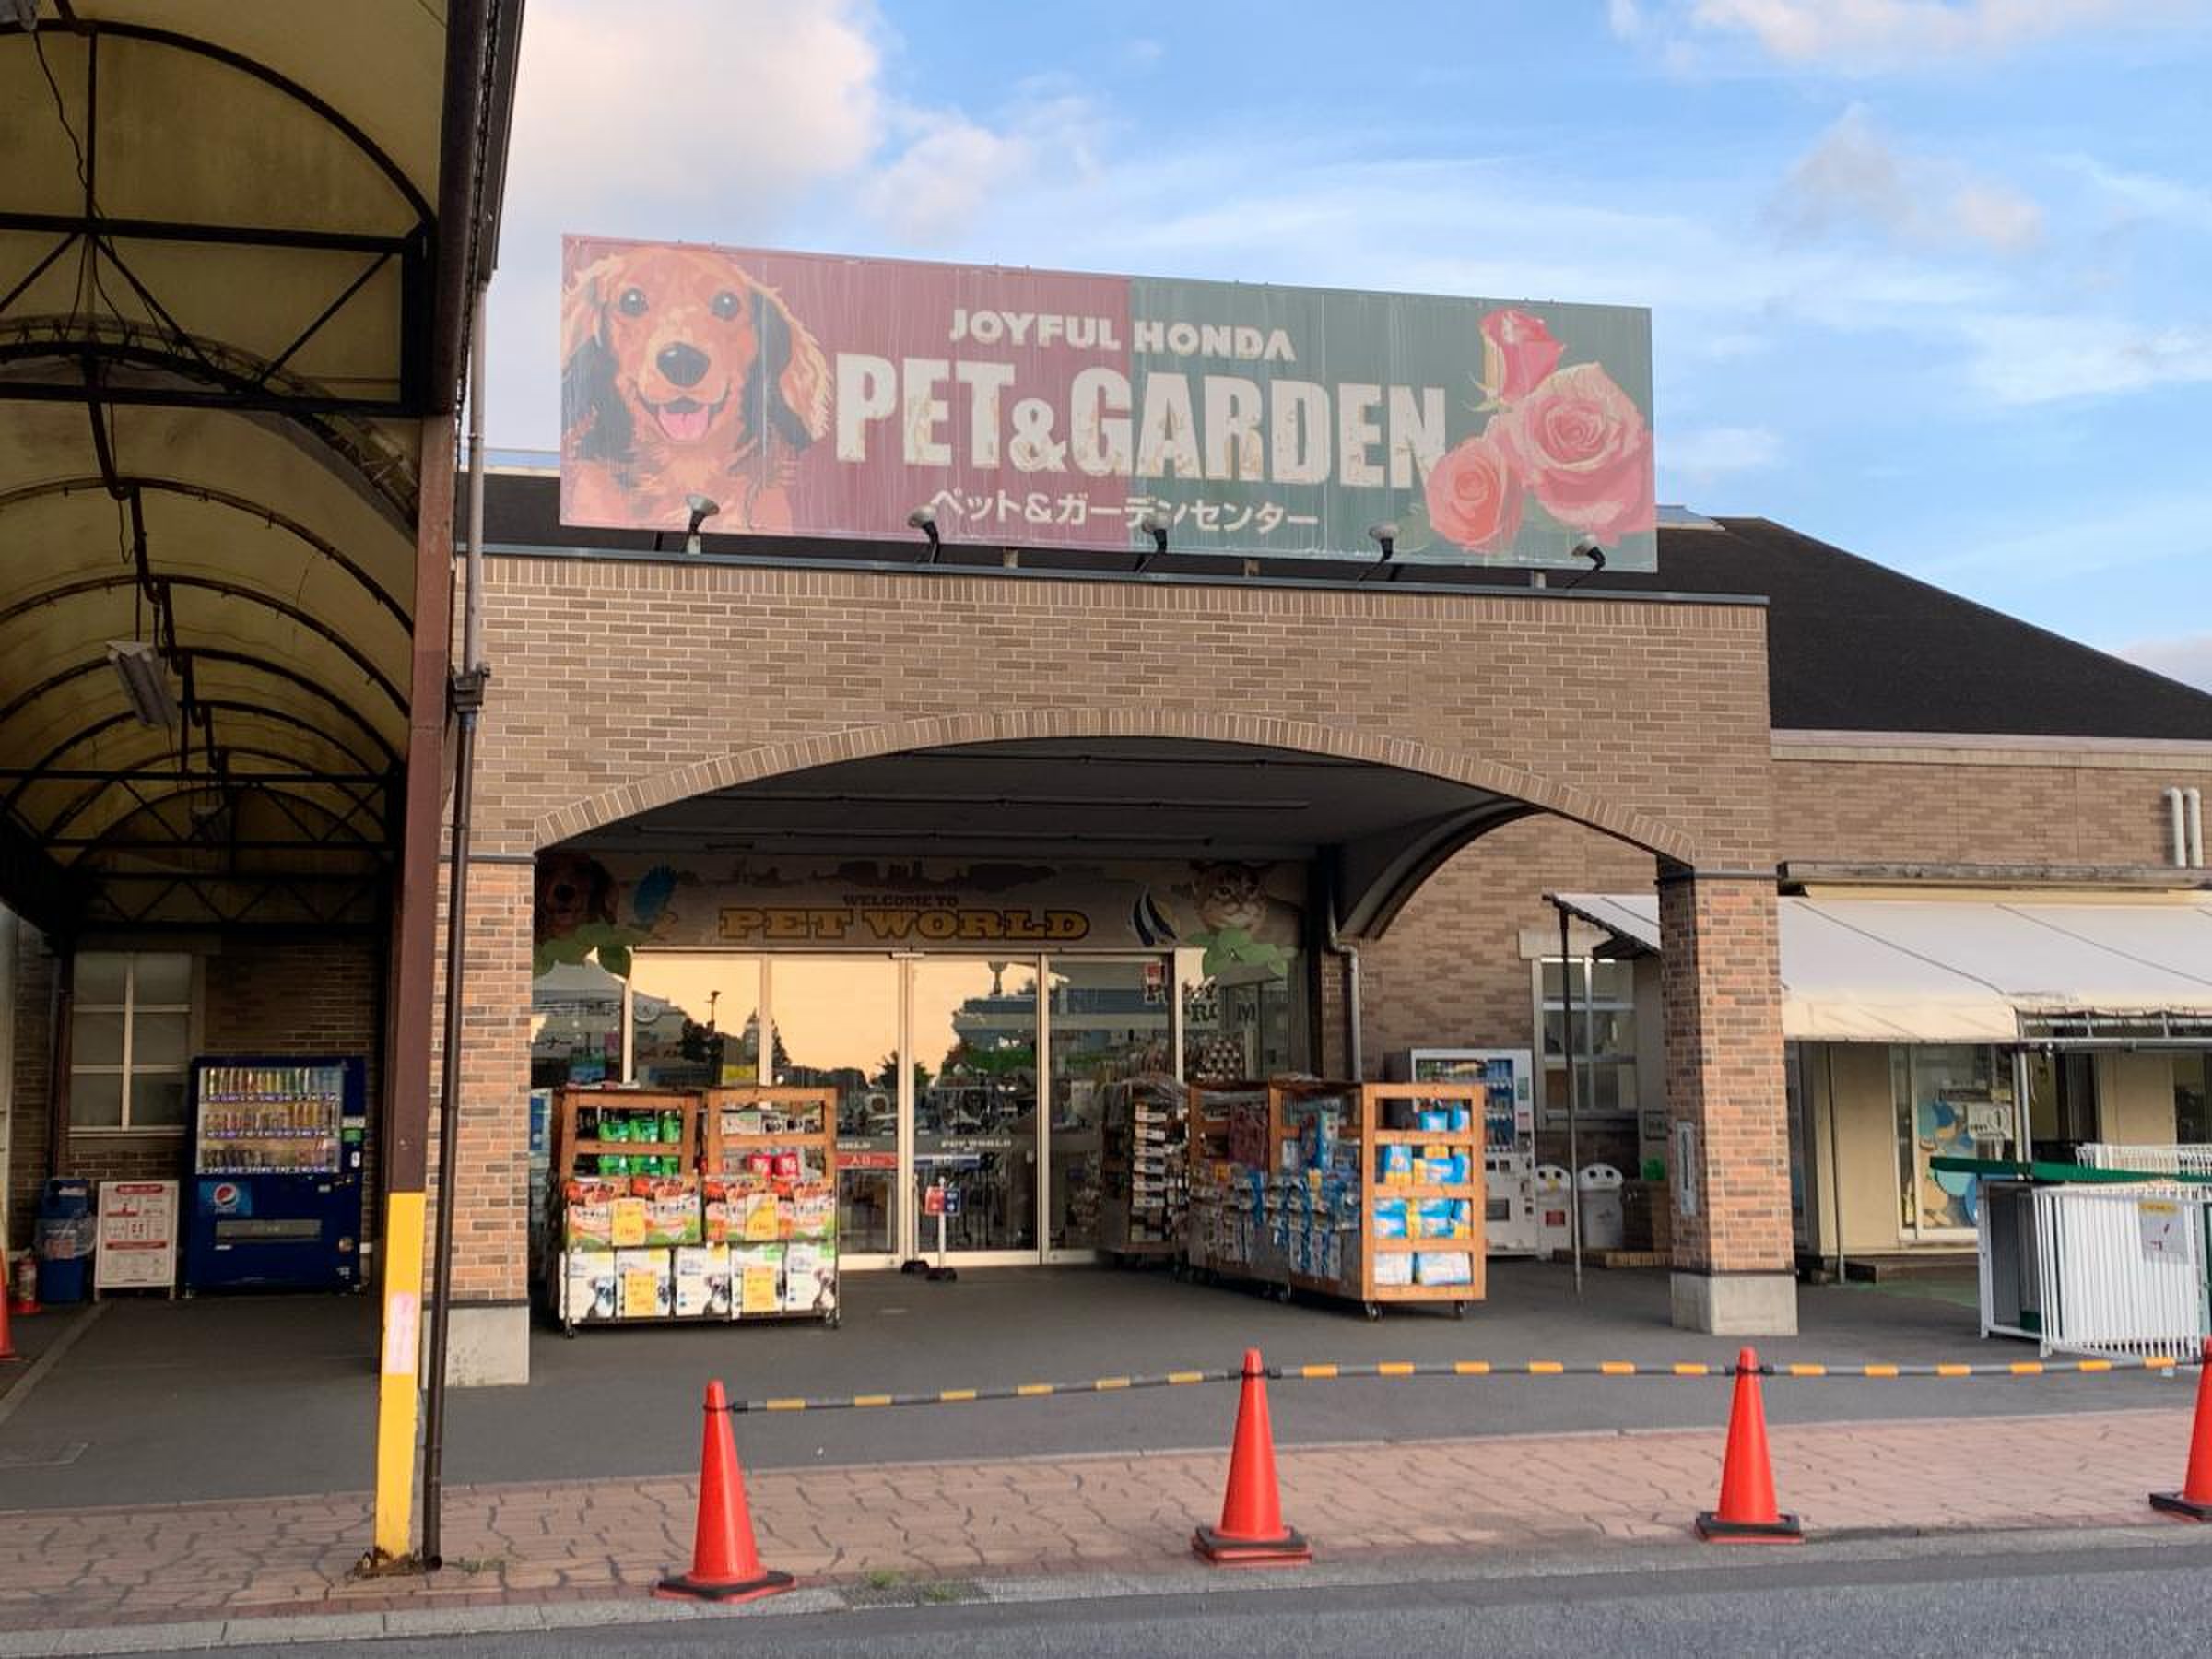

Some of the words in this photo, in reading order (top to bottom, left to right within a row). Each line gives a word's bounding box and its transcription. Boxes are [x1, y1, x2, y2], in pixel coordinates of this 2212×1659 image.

[949, 309, 1122, 351] JOYFUL
[1135, 321, 1295, 362] HONDA
[835, 353, 1446, 489] PET&GARDEN
[842, 895, 930, 906] WELCOME
[934, 895, 959, 906] TO
[720, 907, 854, 939] PET
[862, 909, 1090, 940] WORLD
